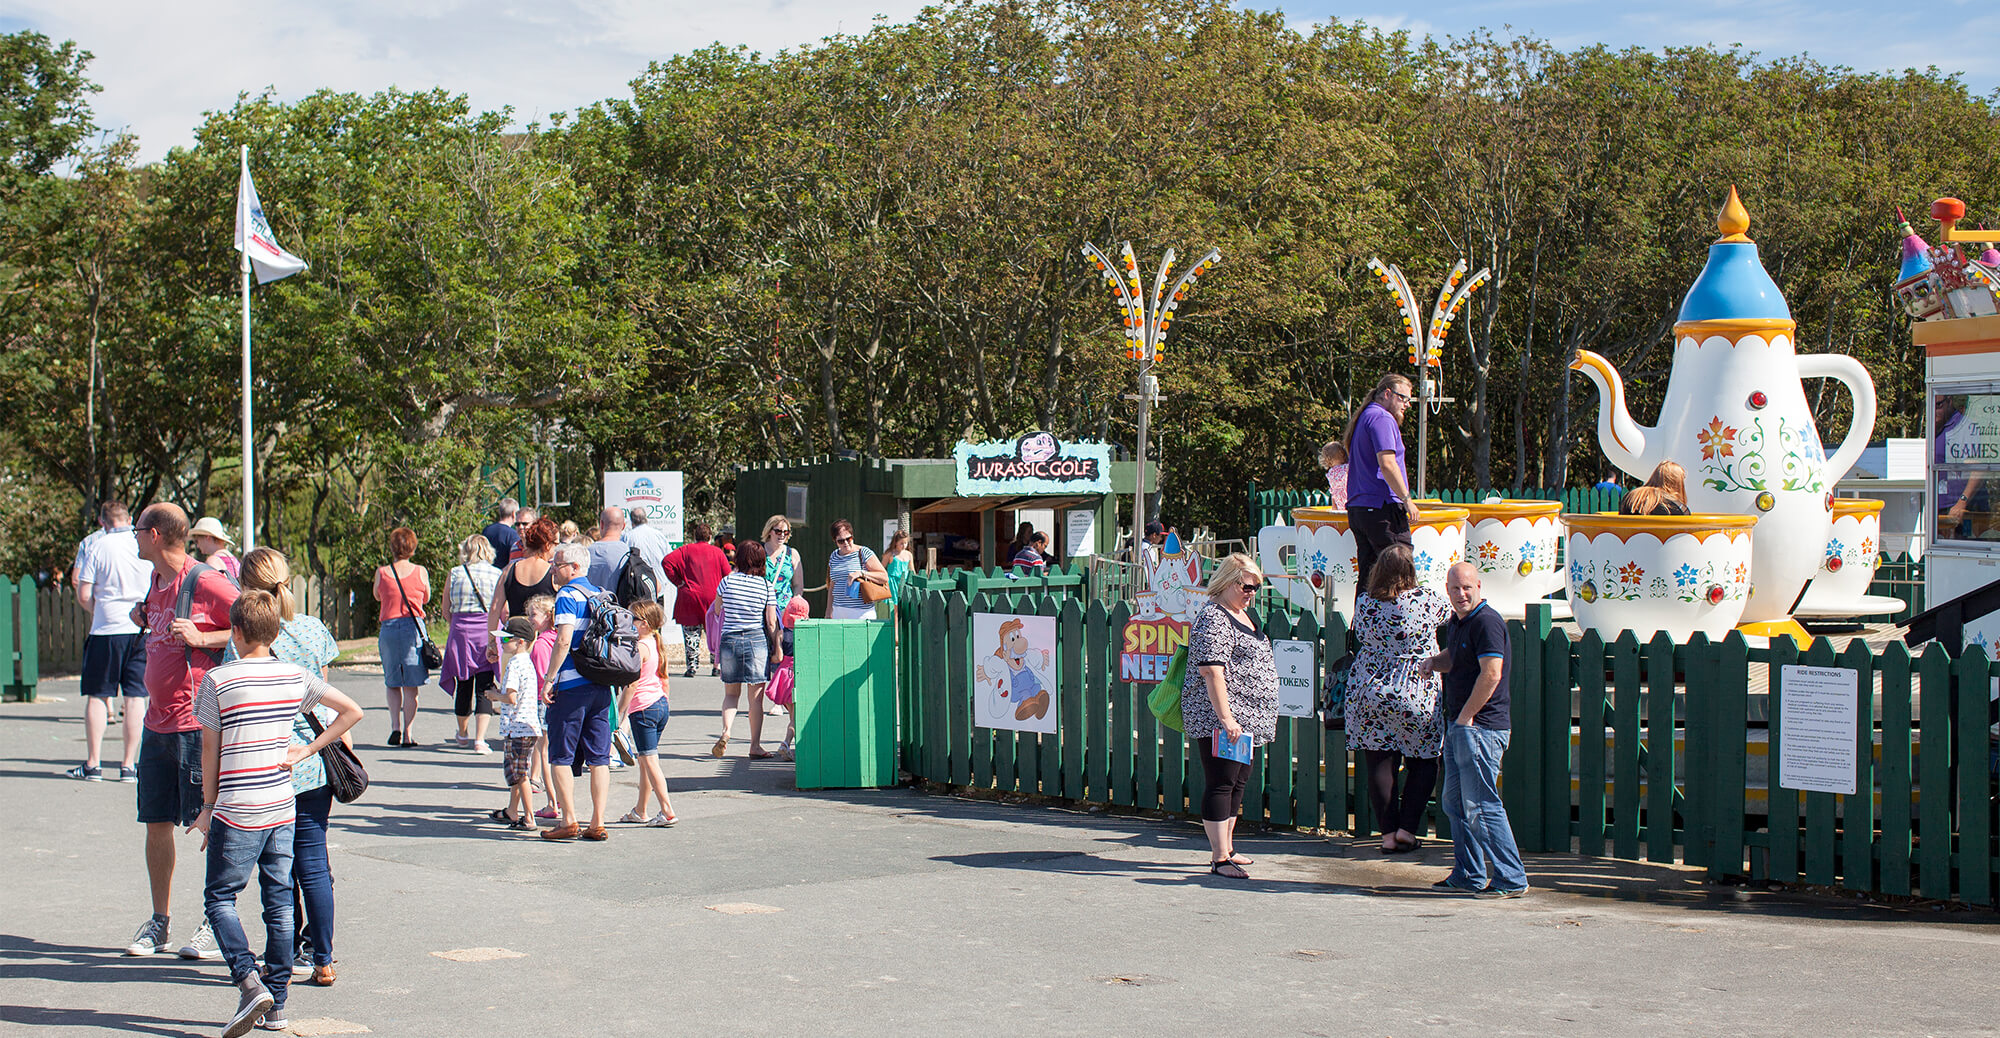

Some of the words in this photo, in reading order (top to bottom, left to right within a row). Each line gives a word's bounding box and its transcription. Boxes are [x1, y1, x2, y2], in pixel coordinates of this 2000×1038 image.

[1968, 421, 2000, 436] Tradit
[1950, 443, 1999, 459] GAMES
[973, 462, 1047, 478] JURASSIC
[1050, 461, 1092, 477] GOLF
[625, 488, 662, 496] NEEDLES
[646, 504, 677, 519] 25%
[1122, 653, 1174, 681] NEE
[1290, 664, 1297, 674] 2
[1278, 676, 1310, 688] TOKENS
